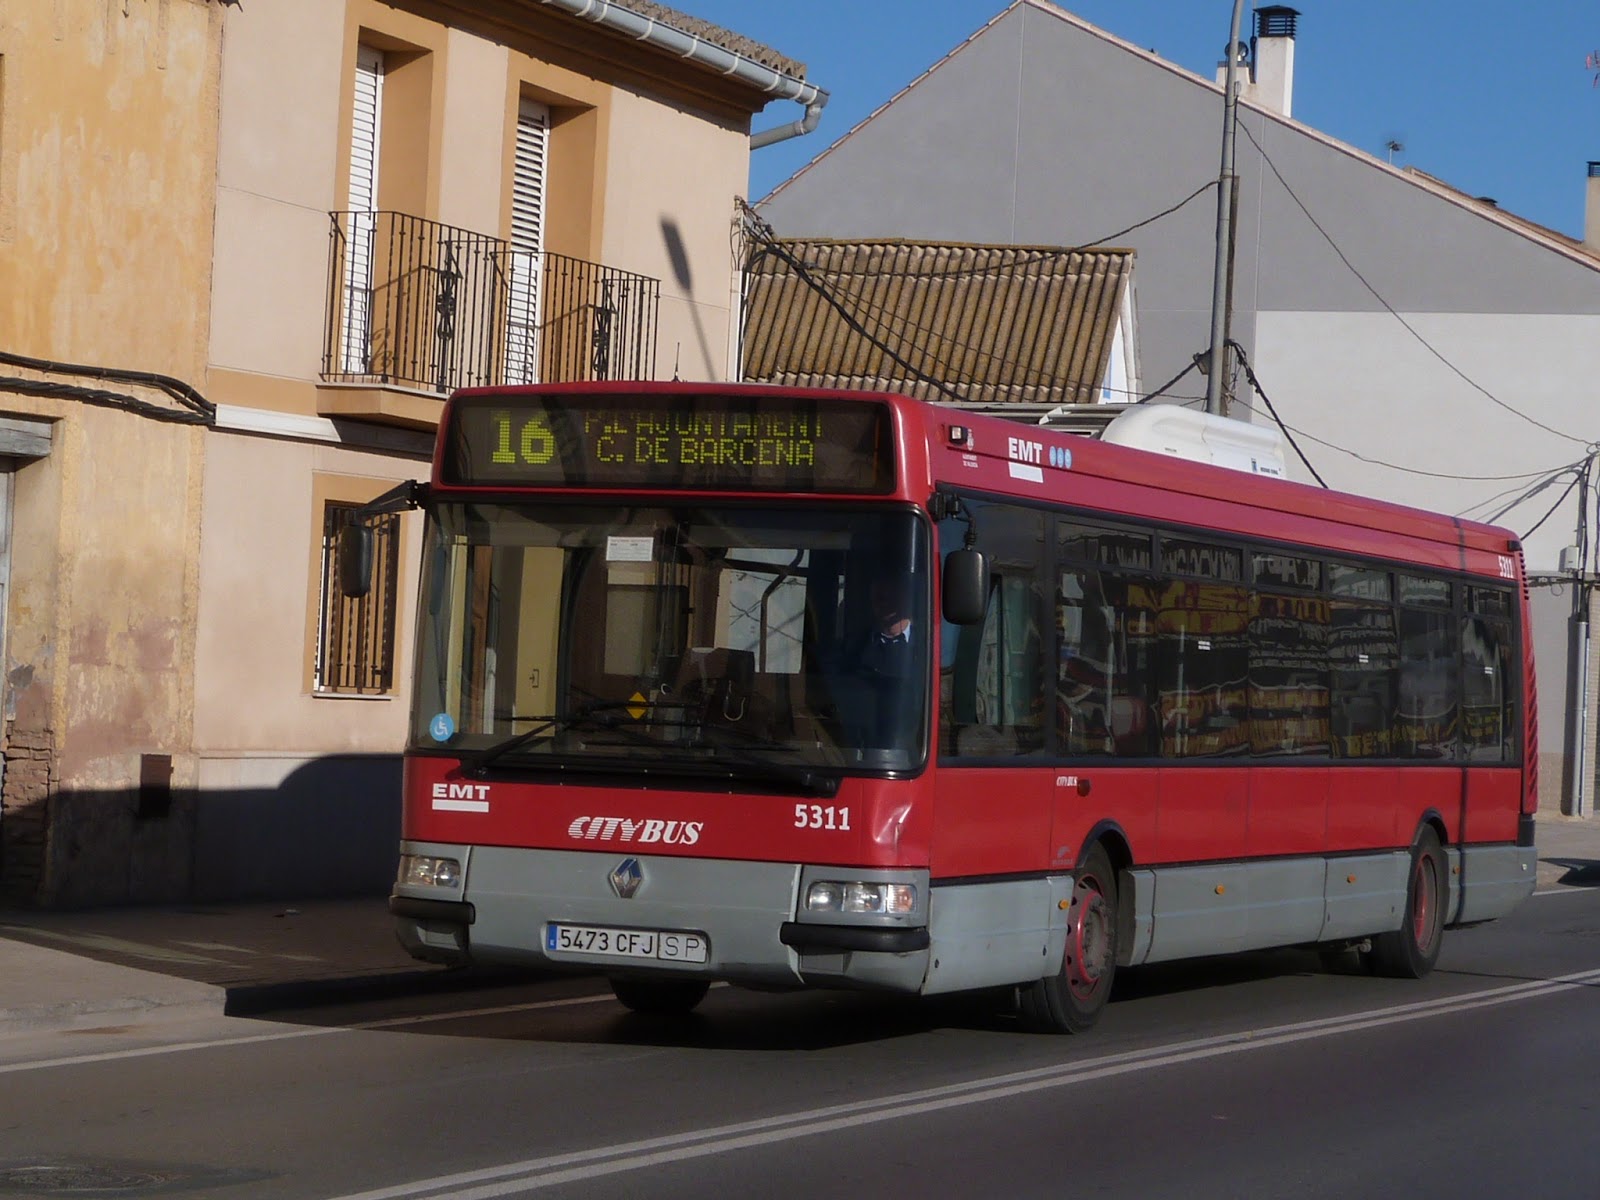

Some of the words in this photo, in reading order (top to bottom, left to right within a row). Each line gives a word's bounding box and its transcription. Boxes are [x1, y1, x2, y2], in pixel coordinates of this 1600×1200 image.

[491, 410, 554, 464] 16
[1008, 437, 1043, 464] EMT
[597, 436, 625, 463] C.
[635, 436, 670, 464] DE
[680, 437, 815, 466] BARCENA
[432, 783, 490, 800] EMT
[794, 803, 851, 831] 5311
[560, 929, 609, 951] 5473
[616, 933, 653, 955] CFJ
